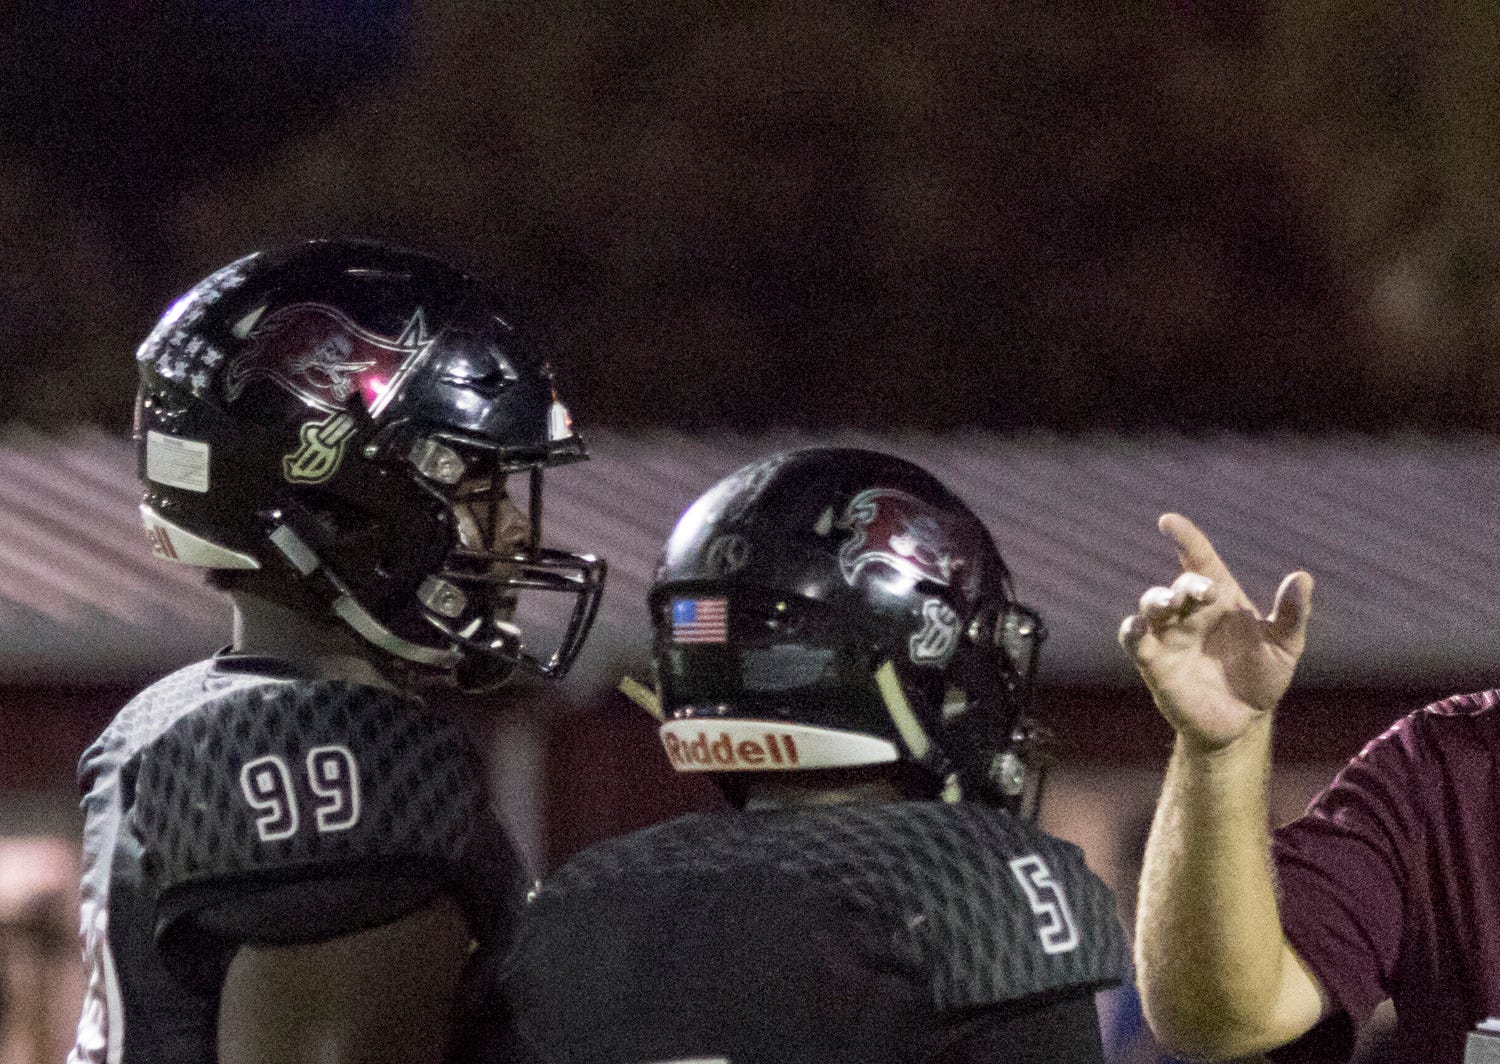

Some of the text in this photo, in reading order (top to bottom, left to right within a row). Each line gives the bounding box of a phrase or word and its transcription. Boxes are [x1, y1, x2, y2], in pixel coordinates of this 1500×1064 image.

[240, 745, 359, 841] 99
[665, 732, 799, 764] Riddell
[1010, 854, 1078, 954] 5
